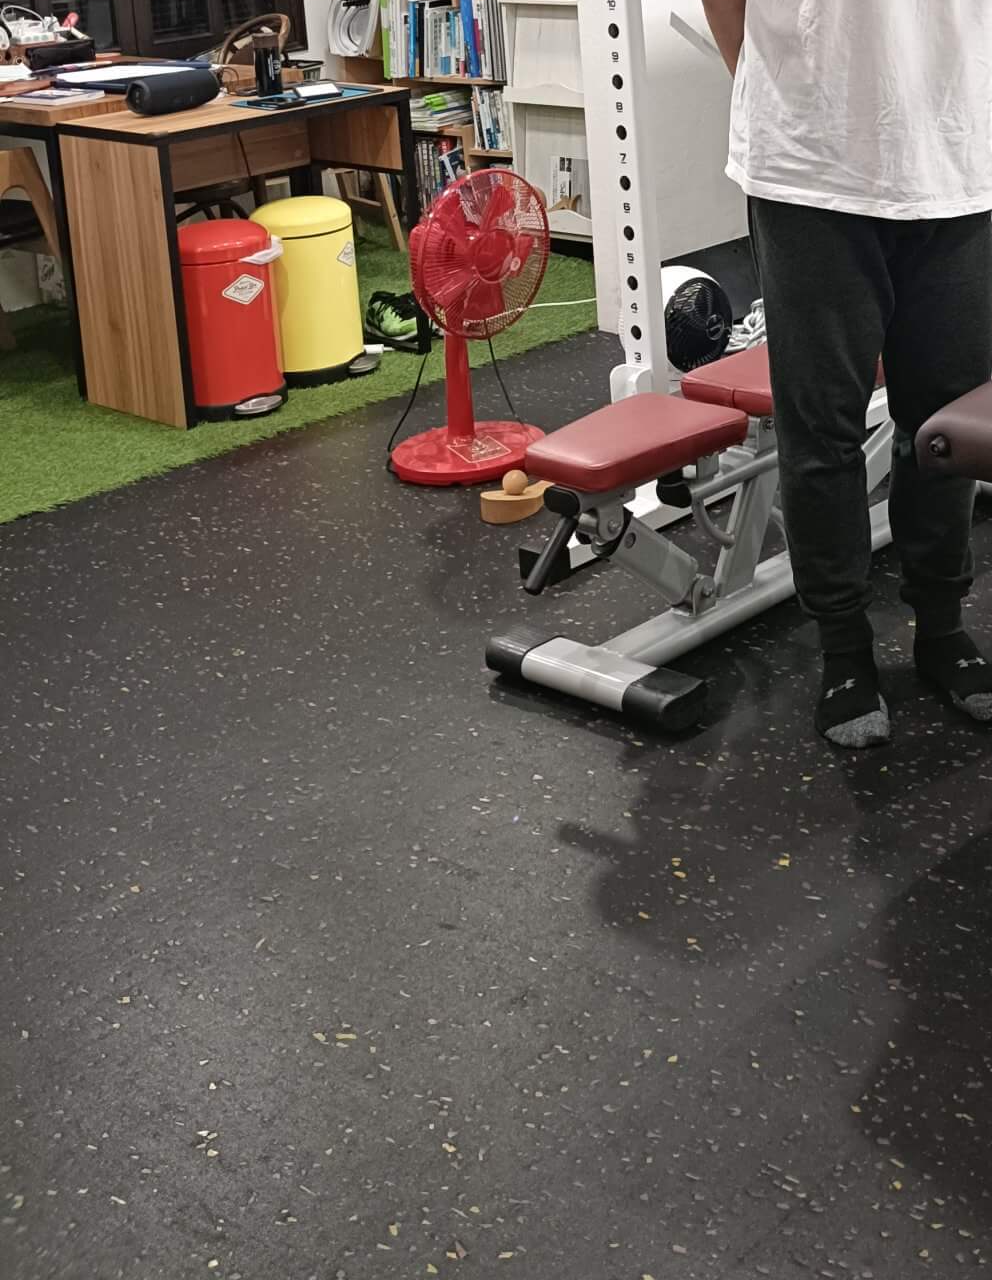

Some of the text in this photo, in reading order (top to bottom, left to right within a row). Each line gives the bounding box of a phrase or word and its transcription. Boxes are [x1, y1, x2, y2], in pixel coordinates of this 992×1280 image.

[608, 0, 615, 10] 10
[612, 52, 618, 62] 9
[616, 102, 623, 112] 8
[620, 153, 626, 163] 7
[624, 203, 630, 213] 6
[627, 253, 634, 263] 5
[631, 303, 637, 313] 4
[635, 352, 641, 362] 3
